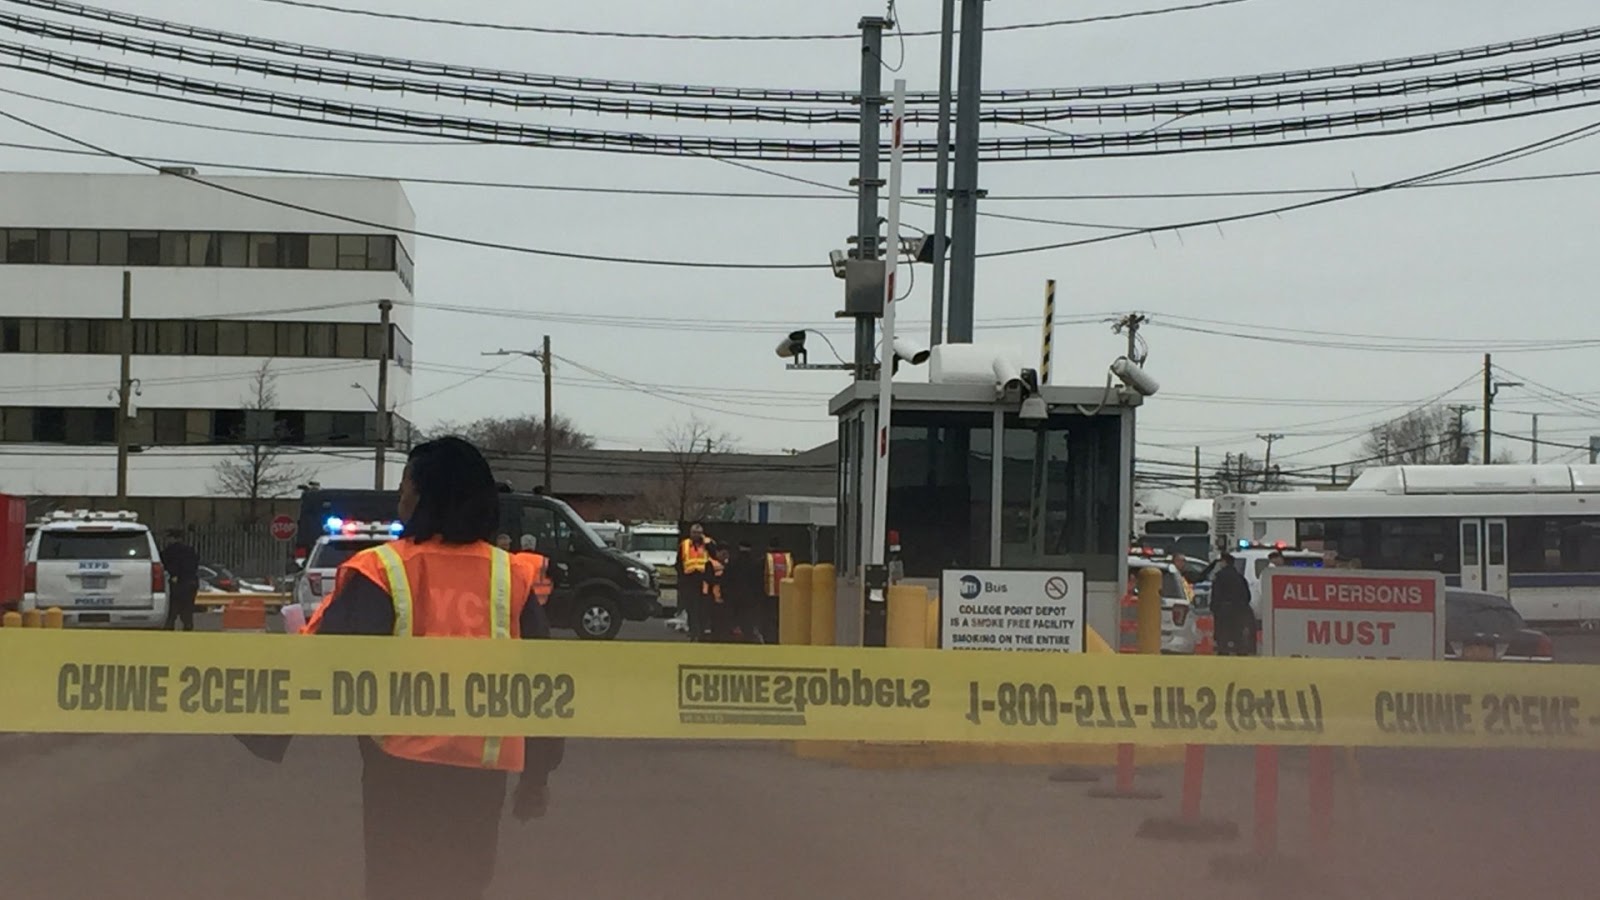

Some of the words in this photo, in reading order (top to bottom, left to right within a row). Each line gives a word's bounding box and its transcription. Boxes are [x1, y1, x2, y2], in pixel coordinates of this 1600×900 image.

[79, 561, 109, 569] NYPD
[985, 582, 1008, 592] Bus
[1283, 583, 1320, 601] ALL
[1324, 584, 1422, 604] PERSONS
[959, 604, 1002, 615] COLLEGE
[1004, 606, 1033, 616] POINT
[1035, 606, 1067, 616] DEPOT
[950, 618, 960, 627] IS
[962, 618, 969, 627] A
[971, 618, 1004, 629] SMOKE
[1007, 619, 1031, 629] FREE
[1033, 620, 1075, 630] FACILITY
[1306, 620, 1396, 646] MUST
[952, 633, 996, 644] SMOKING
[998, 635, 1012, 644] ON
[1015, 635, 1034, 645] THE
[1036, 635, 1071, 646] ENTIRE
